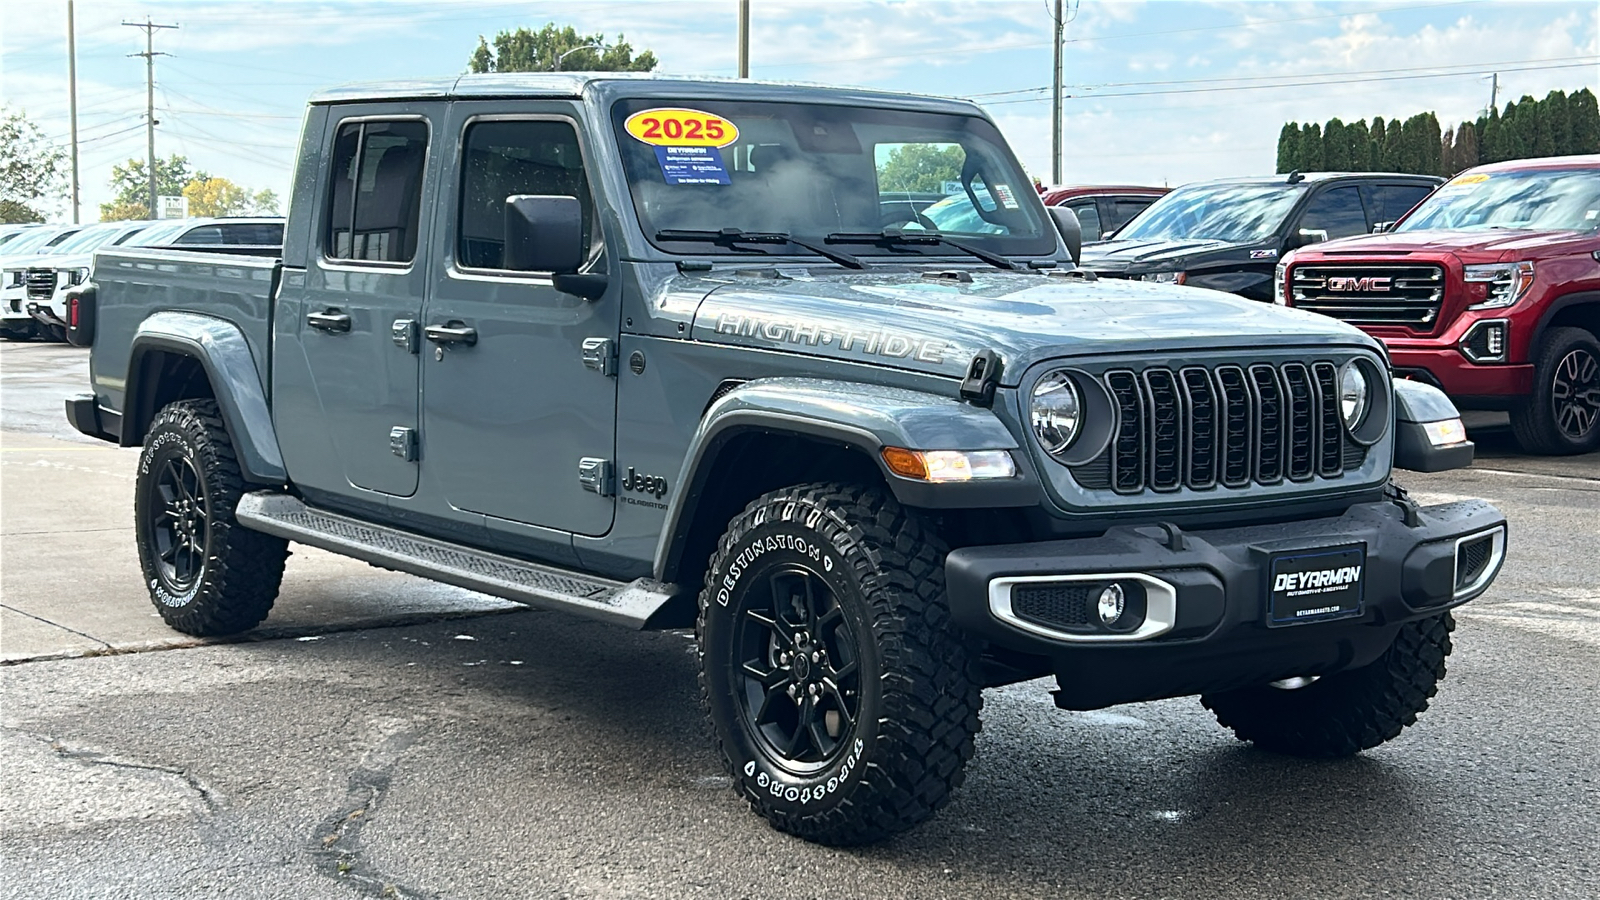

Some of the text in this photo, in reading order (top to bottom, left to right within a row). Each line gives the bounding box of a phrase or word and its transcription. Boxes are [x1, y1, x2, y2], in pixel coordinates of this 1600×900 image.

[641, 117, 725, 140] 2025
[1328, 277, 1391, 292] GMC
[622, 466, 668, 500] Jeep
[716, 534, 820, 607] DESTINATION
[1273, 566, 1361, 592] DEYARMAN
